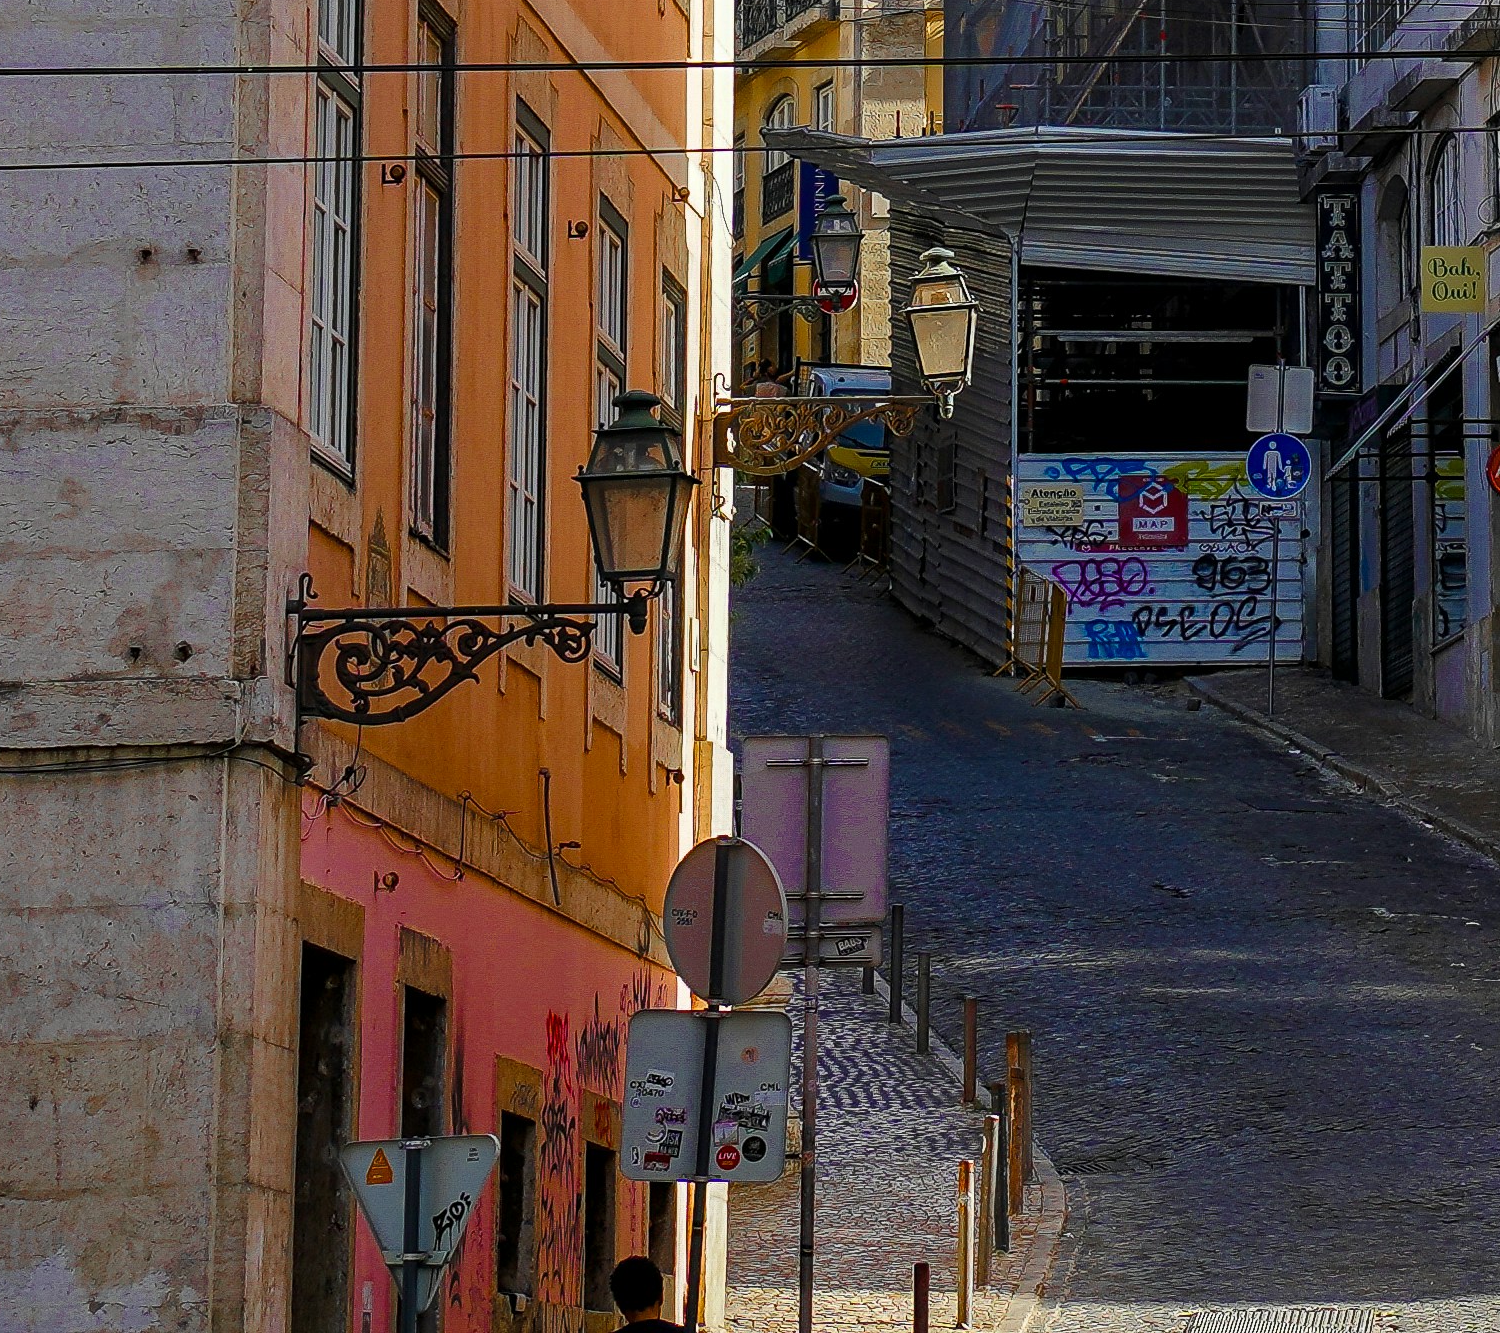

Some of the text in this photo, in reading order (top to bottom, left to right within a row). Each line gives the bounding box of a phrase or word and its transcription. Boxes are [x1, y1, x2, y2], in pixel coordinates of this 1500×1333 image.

[1428, 257, 1481, 280] Bah,
[1321, 198, 1356, 386] TATTOO
[1432, 281, 1478, 302] Oui!
[1138, 520, 1169, 529] MAP
